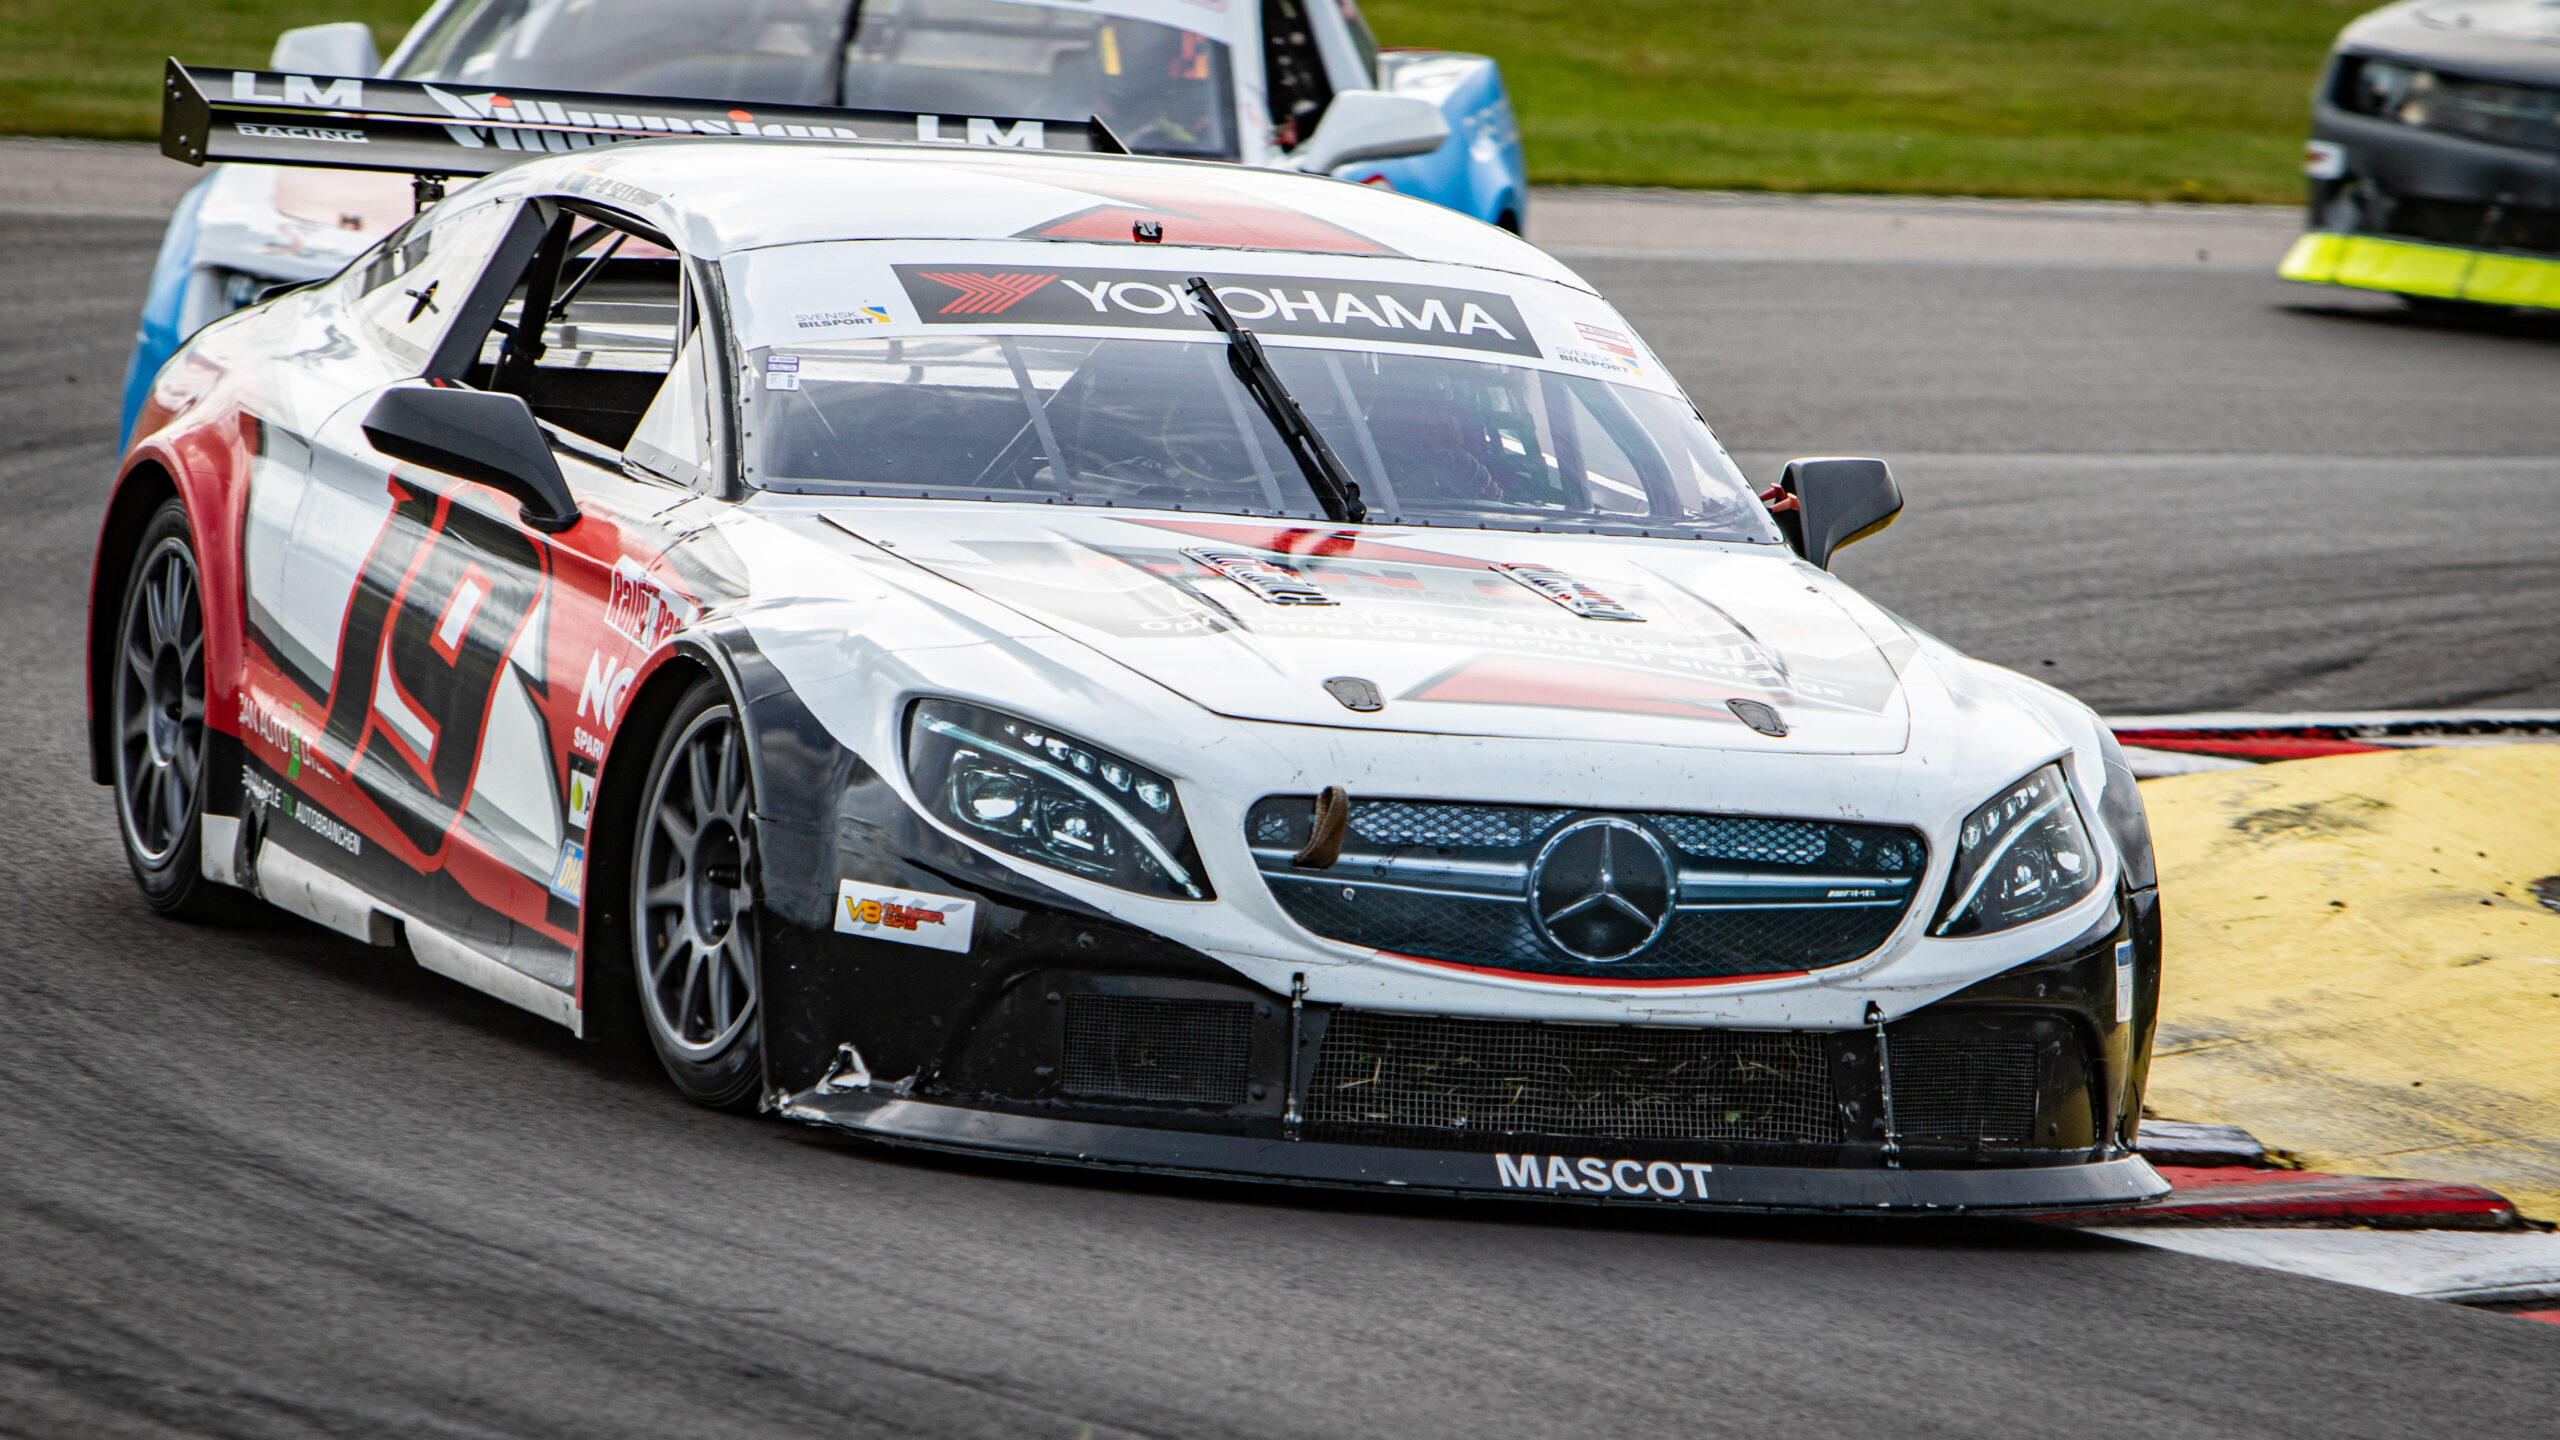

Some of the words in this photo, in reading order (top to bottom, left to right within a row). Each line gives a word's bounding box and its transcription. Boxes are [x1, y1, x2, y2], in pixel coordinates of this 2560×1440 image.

[232, 71, 363, 108] LM
[234, 123, 370, 144] RACING
[917, 115, 1044, 149] LM
[794, 310, 858, 322] SVENSK
[798, 317, 875, 329] BILSPORT
[1060, 279, 1517, 341] YOKOHAMA
[1558, 353, 1629, 373] BILSPORT
[607, 570, 650, 642] Rally
[318, 462, 551, 873] 19
[260, 708, 289, 753] AUTO
[295, 801, 362, 857] AUTOBRANCHEN
[845, 895, 882, 924] V8
[1495, 1153, 1713, 1199] MASCOT
